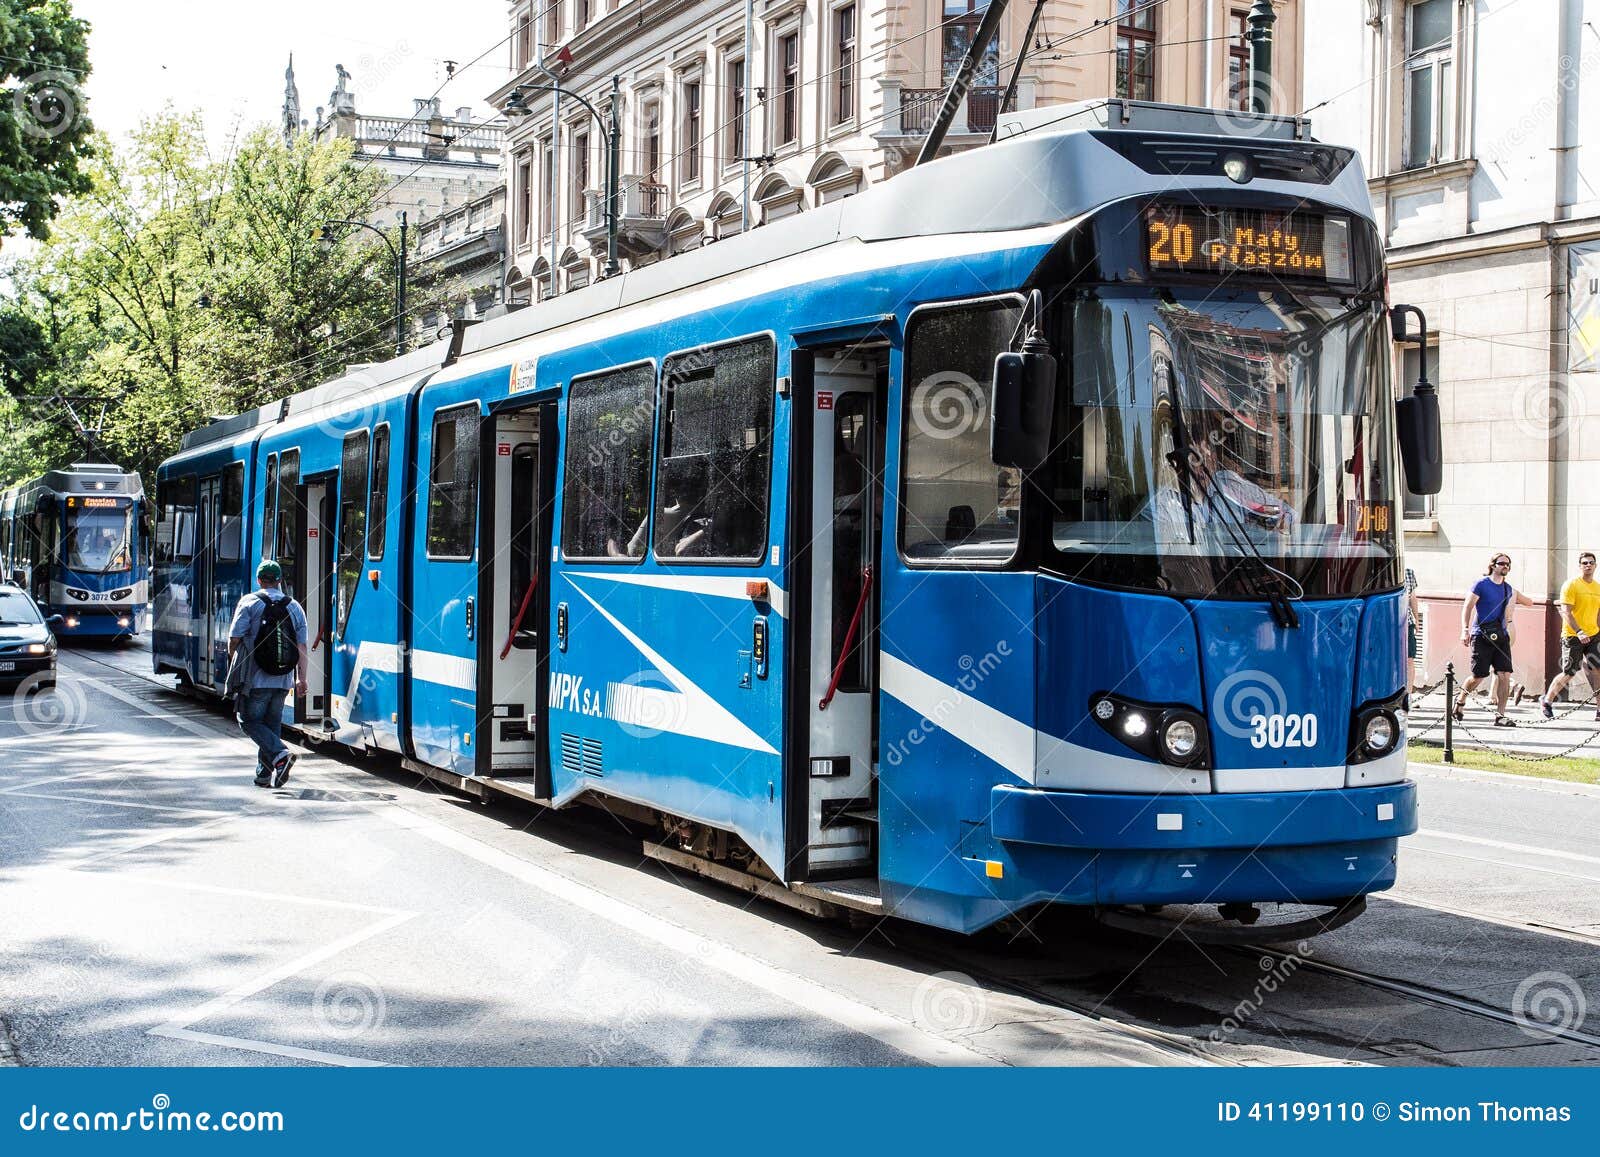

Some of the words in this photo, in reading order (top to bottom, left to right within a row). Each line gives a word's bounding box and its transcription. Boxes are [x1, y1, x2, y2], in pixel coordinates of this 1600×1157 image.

[1150, 222, 1192, 262] 20
[1235, 227, 1297, 251] Mały
[1211, 244, 1322, 268] Płaszów
[68, 497, 75, 507] 2
[1356, 506, 1388, 531] 20-08
[91, 593, 109, 601] 3072
[549, 672, 583, 713] MPK
[582, 688, 602, 718] S.A.
[1250, 713, 1318, 749] 3020
